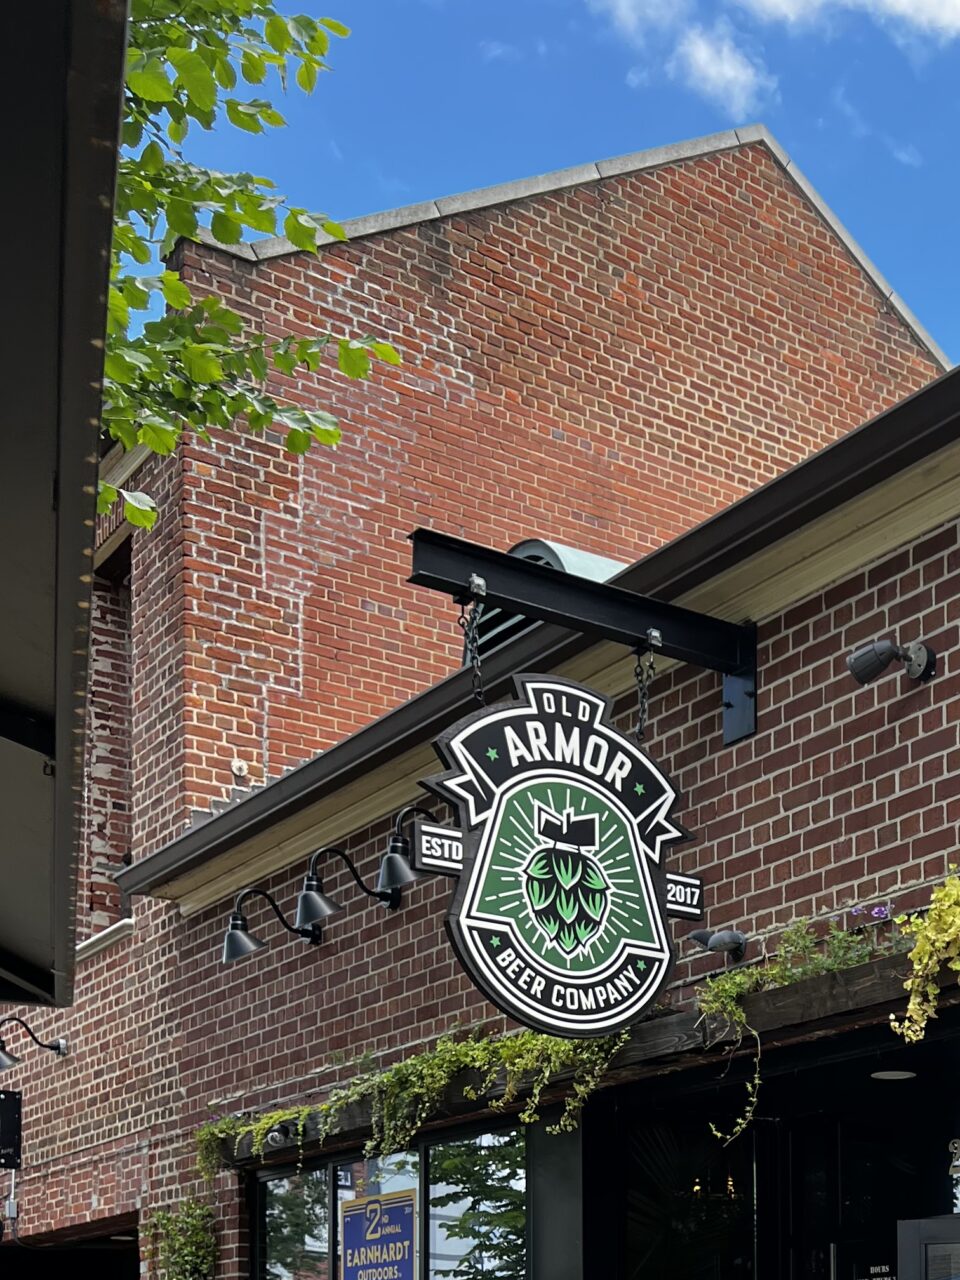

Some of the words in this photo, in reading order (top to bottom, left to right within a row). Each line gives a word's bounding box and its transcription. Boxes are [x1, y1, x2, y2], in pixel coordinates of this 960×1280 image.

[542, 692, 591, 722] OLD
[503, 720, 633, 793] ARMOR
[421, 835, 463, 860] ESTD
[666, 883, 700, 905] 2017
[495, 947, 546, 999] BEER
[551, 964, 641, 1010] COMPANY
[365, 1202, 381, 1241] 2
[346, 1240, 410, 1267] EARNHARDT
[869, 1265, 890, 1274] HOURS
